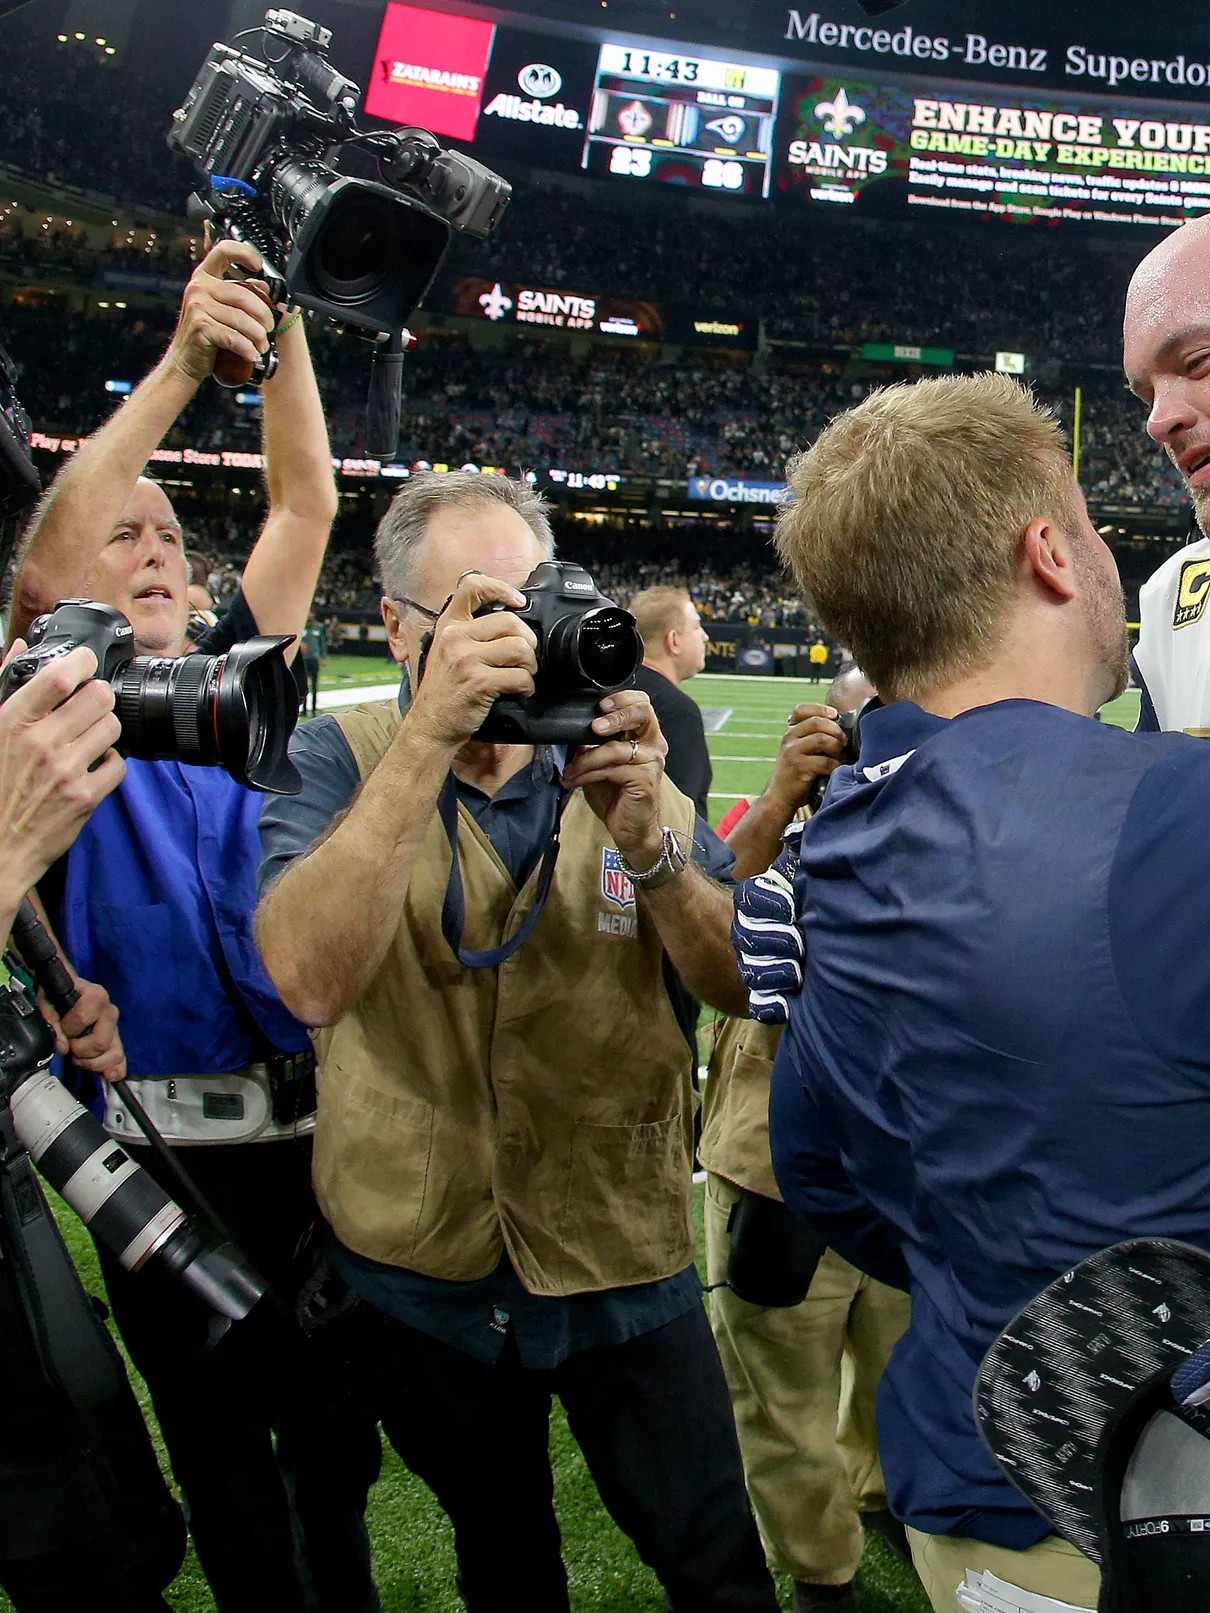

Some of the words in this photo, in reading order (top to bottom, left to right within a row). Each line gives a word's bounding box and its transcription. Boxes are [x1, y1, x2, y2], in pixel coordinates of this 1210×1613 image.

[784, 10, 1048, 72] Mercedes-Benz
[621, 52, 700, 82] 11:43
[910, 98, 1103, 143] ENHANCE
[788, 140, 888, 174] SAINTS
[909, 130, 1054, 163] GAME-DAY
[518, 289, 596, 319] SAINTS
[564, 581, 593, 591] Canon
